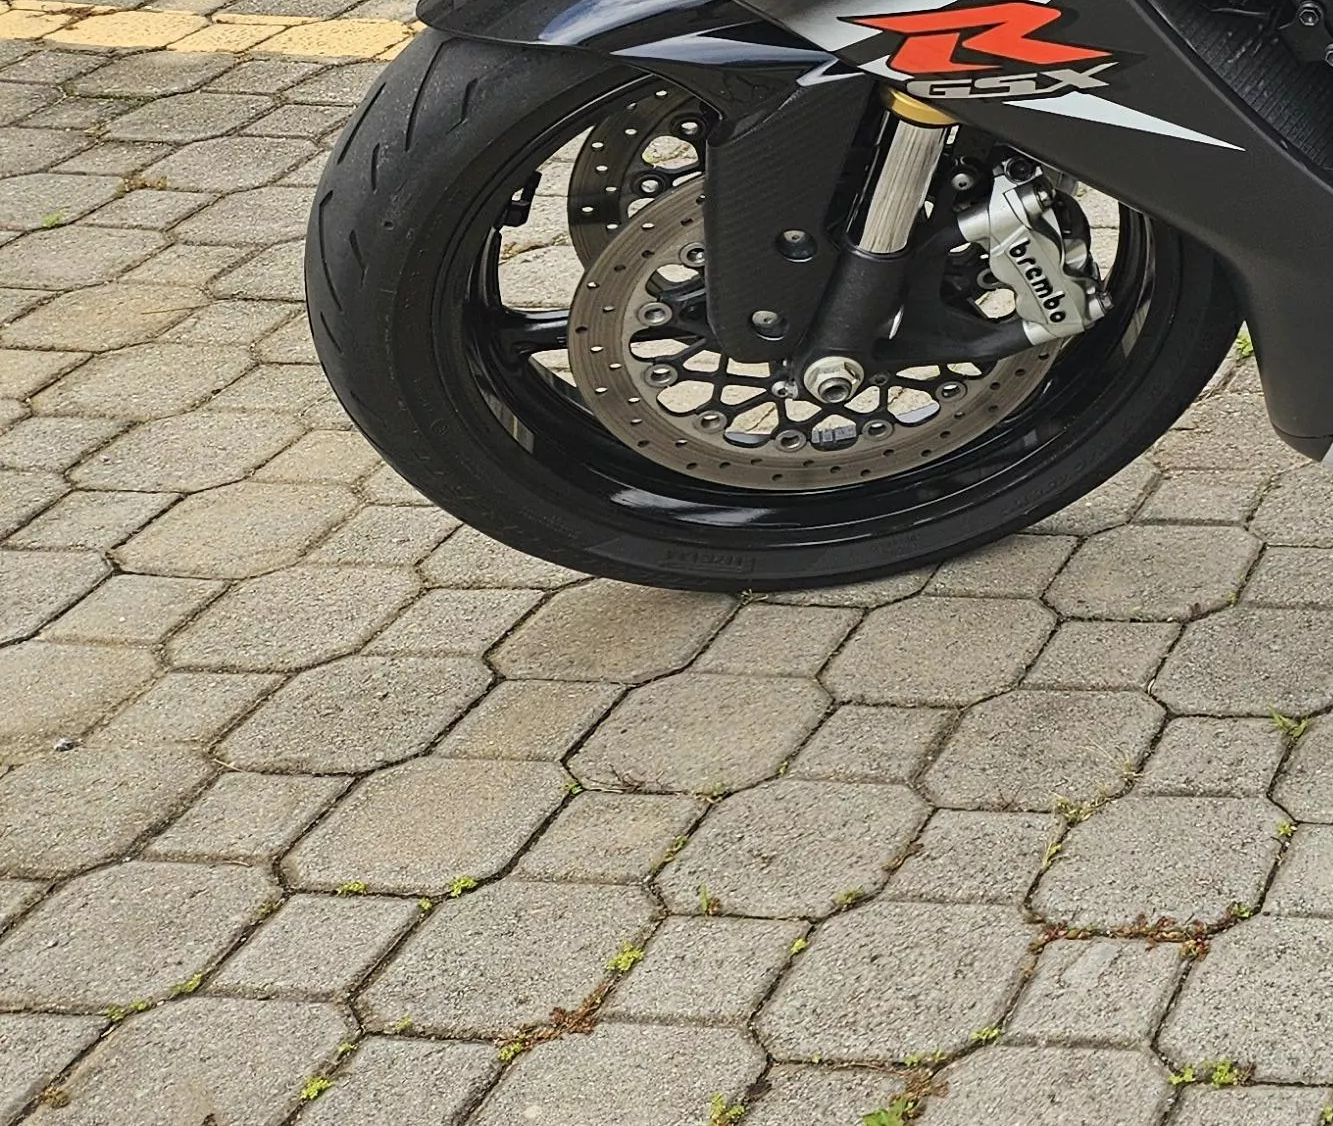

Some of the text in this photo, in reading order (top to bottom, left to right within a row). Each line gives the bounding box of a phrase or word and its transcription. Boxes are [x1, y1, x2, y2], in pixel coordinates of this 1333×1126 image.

[836, 0, 1113, 73] R
[906, 61, 1120, 99] GSX
[1009, 236, 1066, 323] brembo
